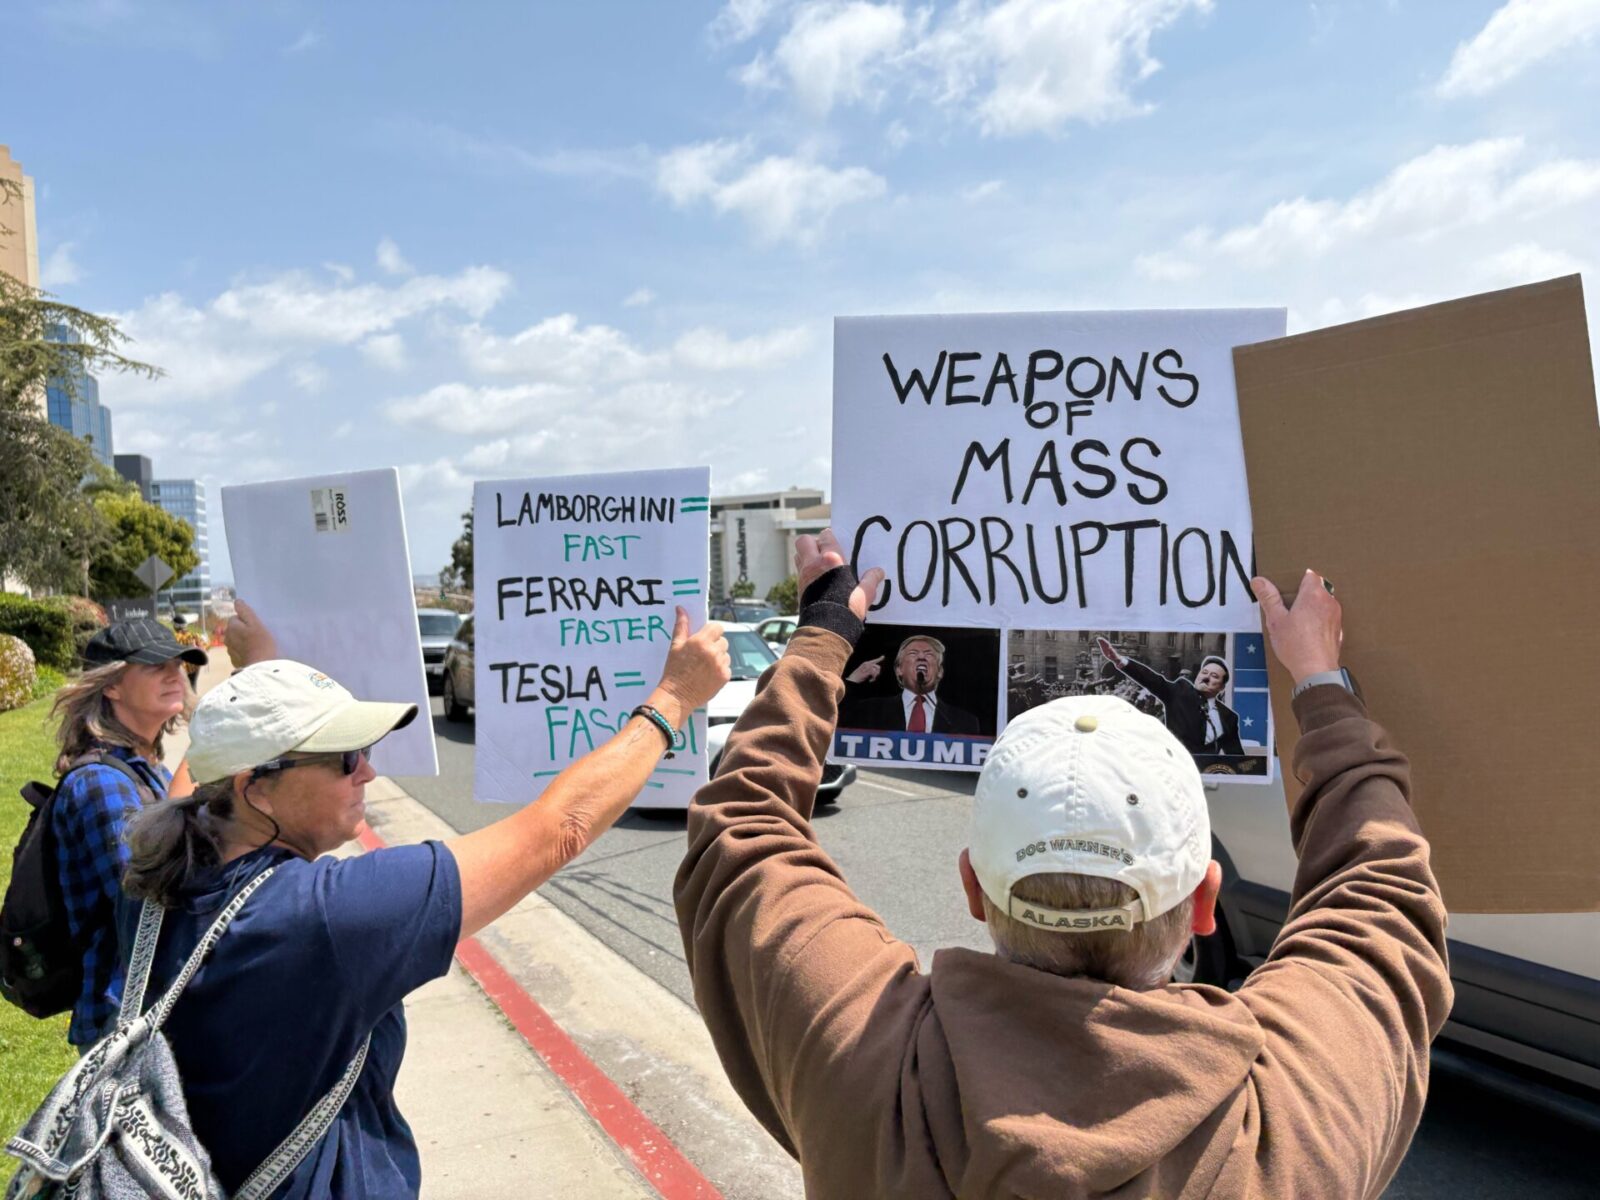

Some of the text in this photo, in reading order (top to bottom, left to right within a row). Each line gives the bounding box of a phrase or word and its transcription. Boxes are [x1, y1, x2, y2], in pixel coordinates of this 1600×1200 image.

[882, 349, 1199, 408] WEAPONS
[1024, 400, 1095, 436] OF
[951, 437, 1168, 506] MASS
[335, 493, 347, 526] ROSS
[496, 493, 675, 527] LAMBORGHINI
[563, 533, 641, 562] FAST
[851, 515, 1258, 611] CORRUPTION
[497, 576, 666, 621] FERRARI
[559, 615, 672, 647] FASTER
[489, 662, 607, 704] TESLA
[840, 735, 992, 765] TRUMP
[1016, 838, 1135, 866] DOC WARNER'S
[1022, 909, 1125, 929] ALASKA
